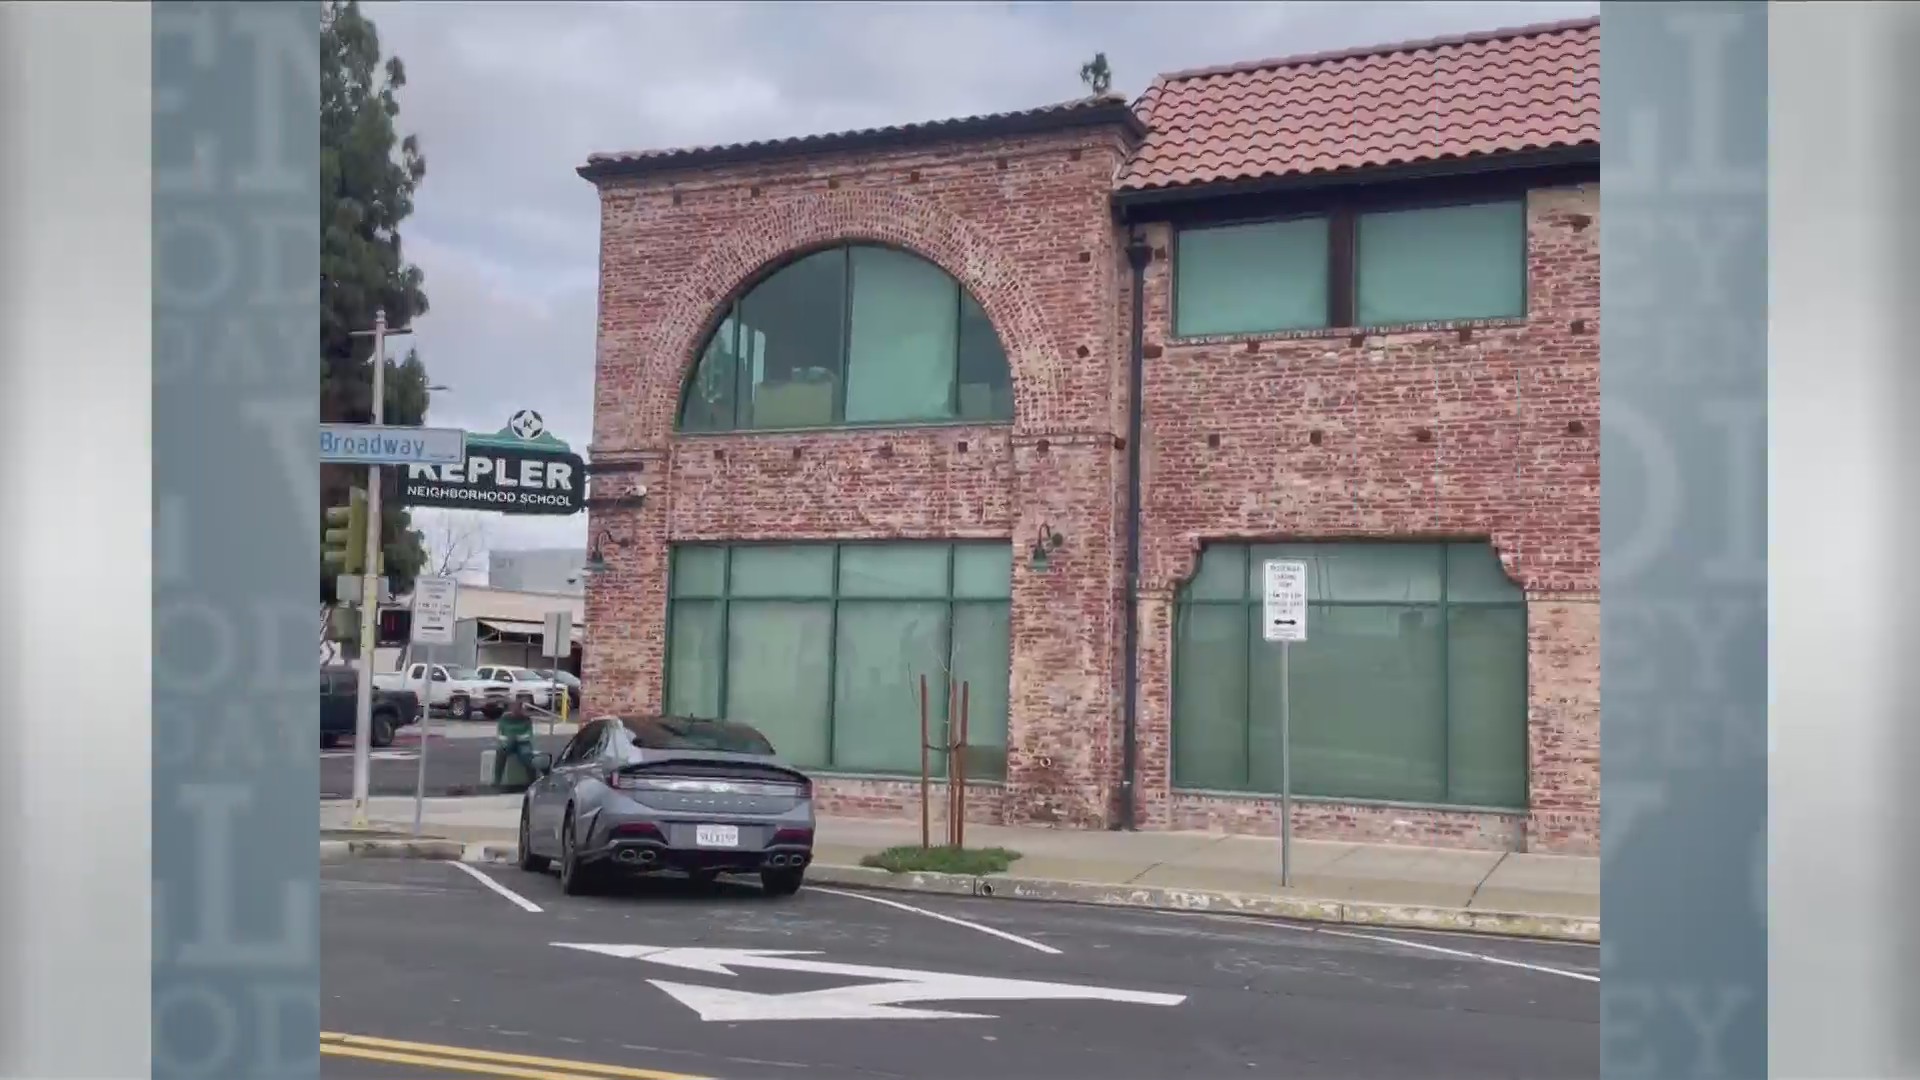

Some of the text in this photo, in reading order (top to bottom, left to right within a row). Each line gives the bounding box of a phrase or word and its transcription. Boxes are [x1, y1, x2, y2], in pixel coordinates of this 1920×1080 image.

[320, 431, 425, 458] Broadway
[407, 486, 573, 507] NEIGHBORHOOD SCHOOL
